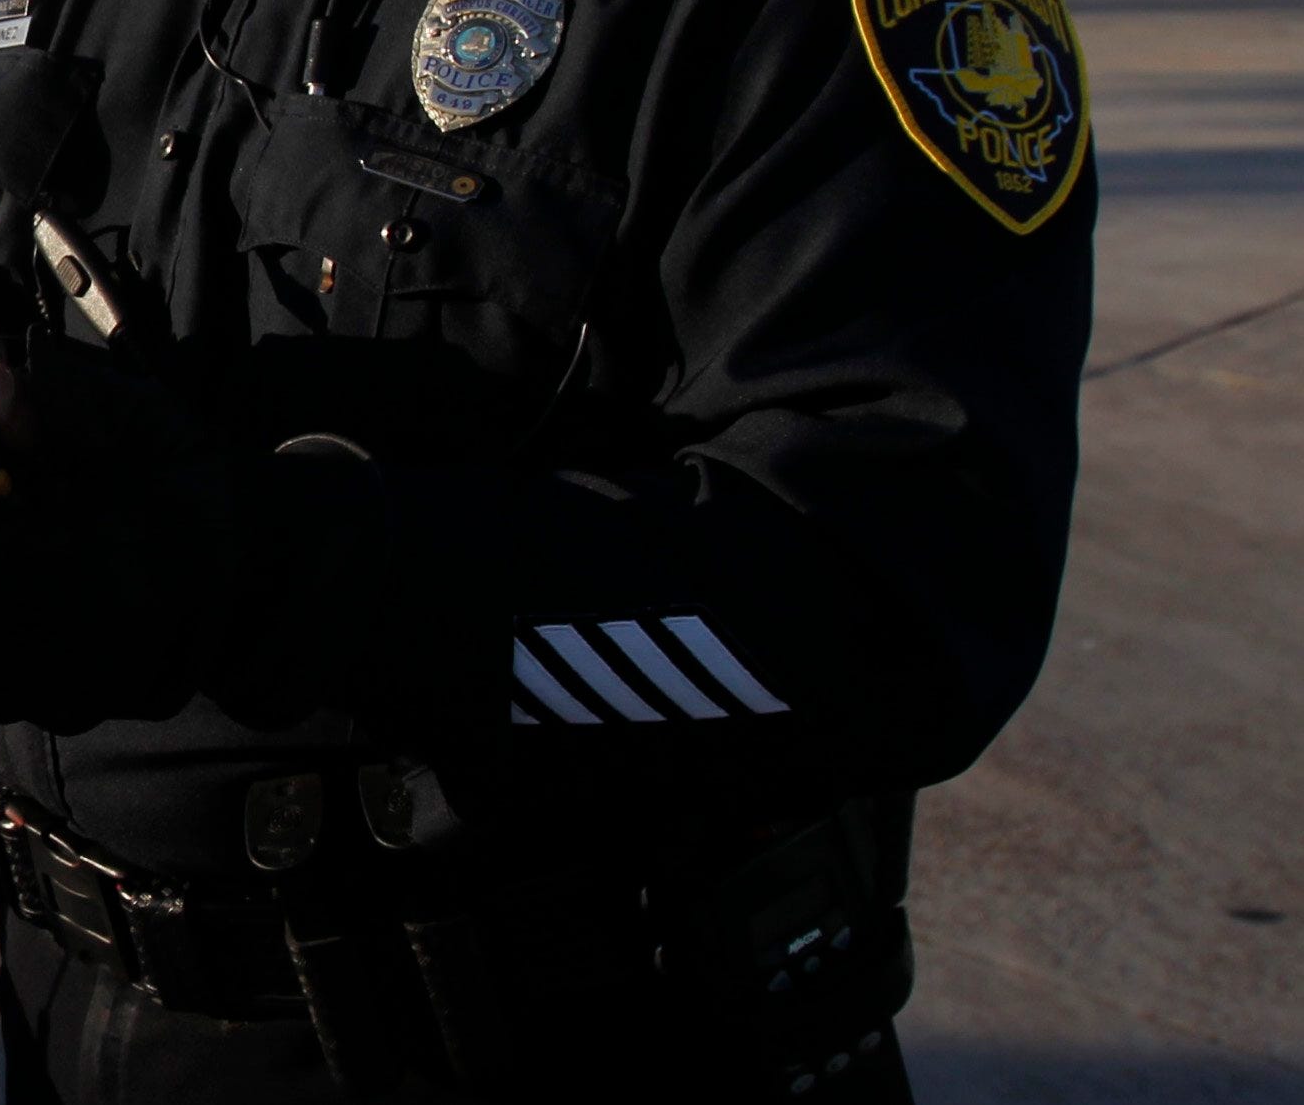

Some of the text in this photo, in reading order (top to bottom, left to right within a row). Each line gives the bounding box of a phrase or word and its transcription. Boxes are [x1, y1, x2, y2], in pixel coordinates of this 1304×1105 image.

[495, 0, 540, 36] CHRISTI
[424, 57, 513, 89] POLICE
[437, 94, 473, 111] 649
[956, 115, 1057, 167] POLICE
[995, 171, 1034, 194] 1852
